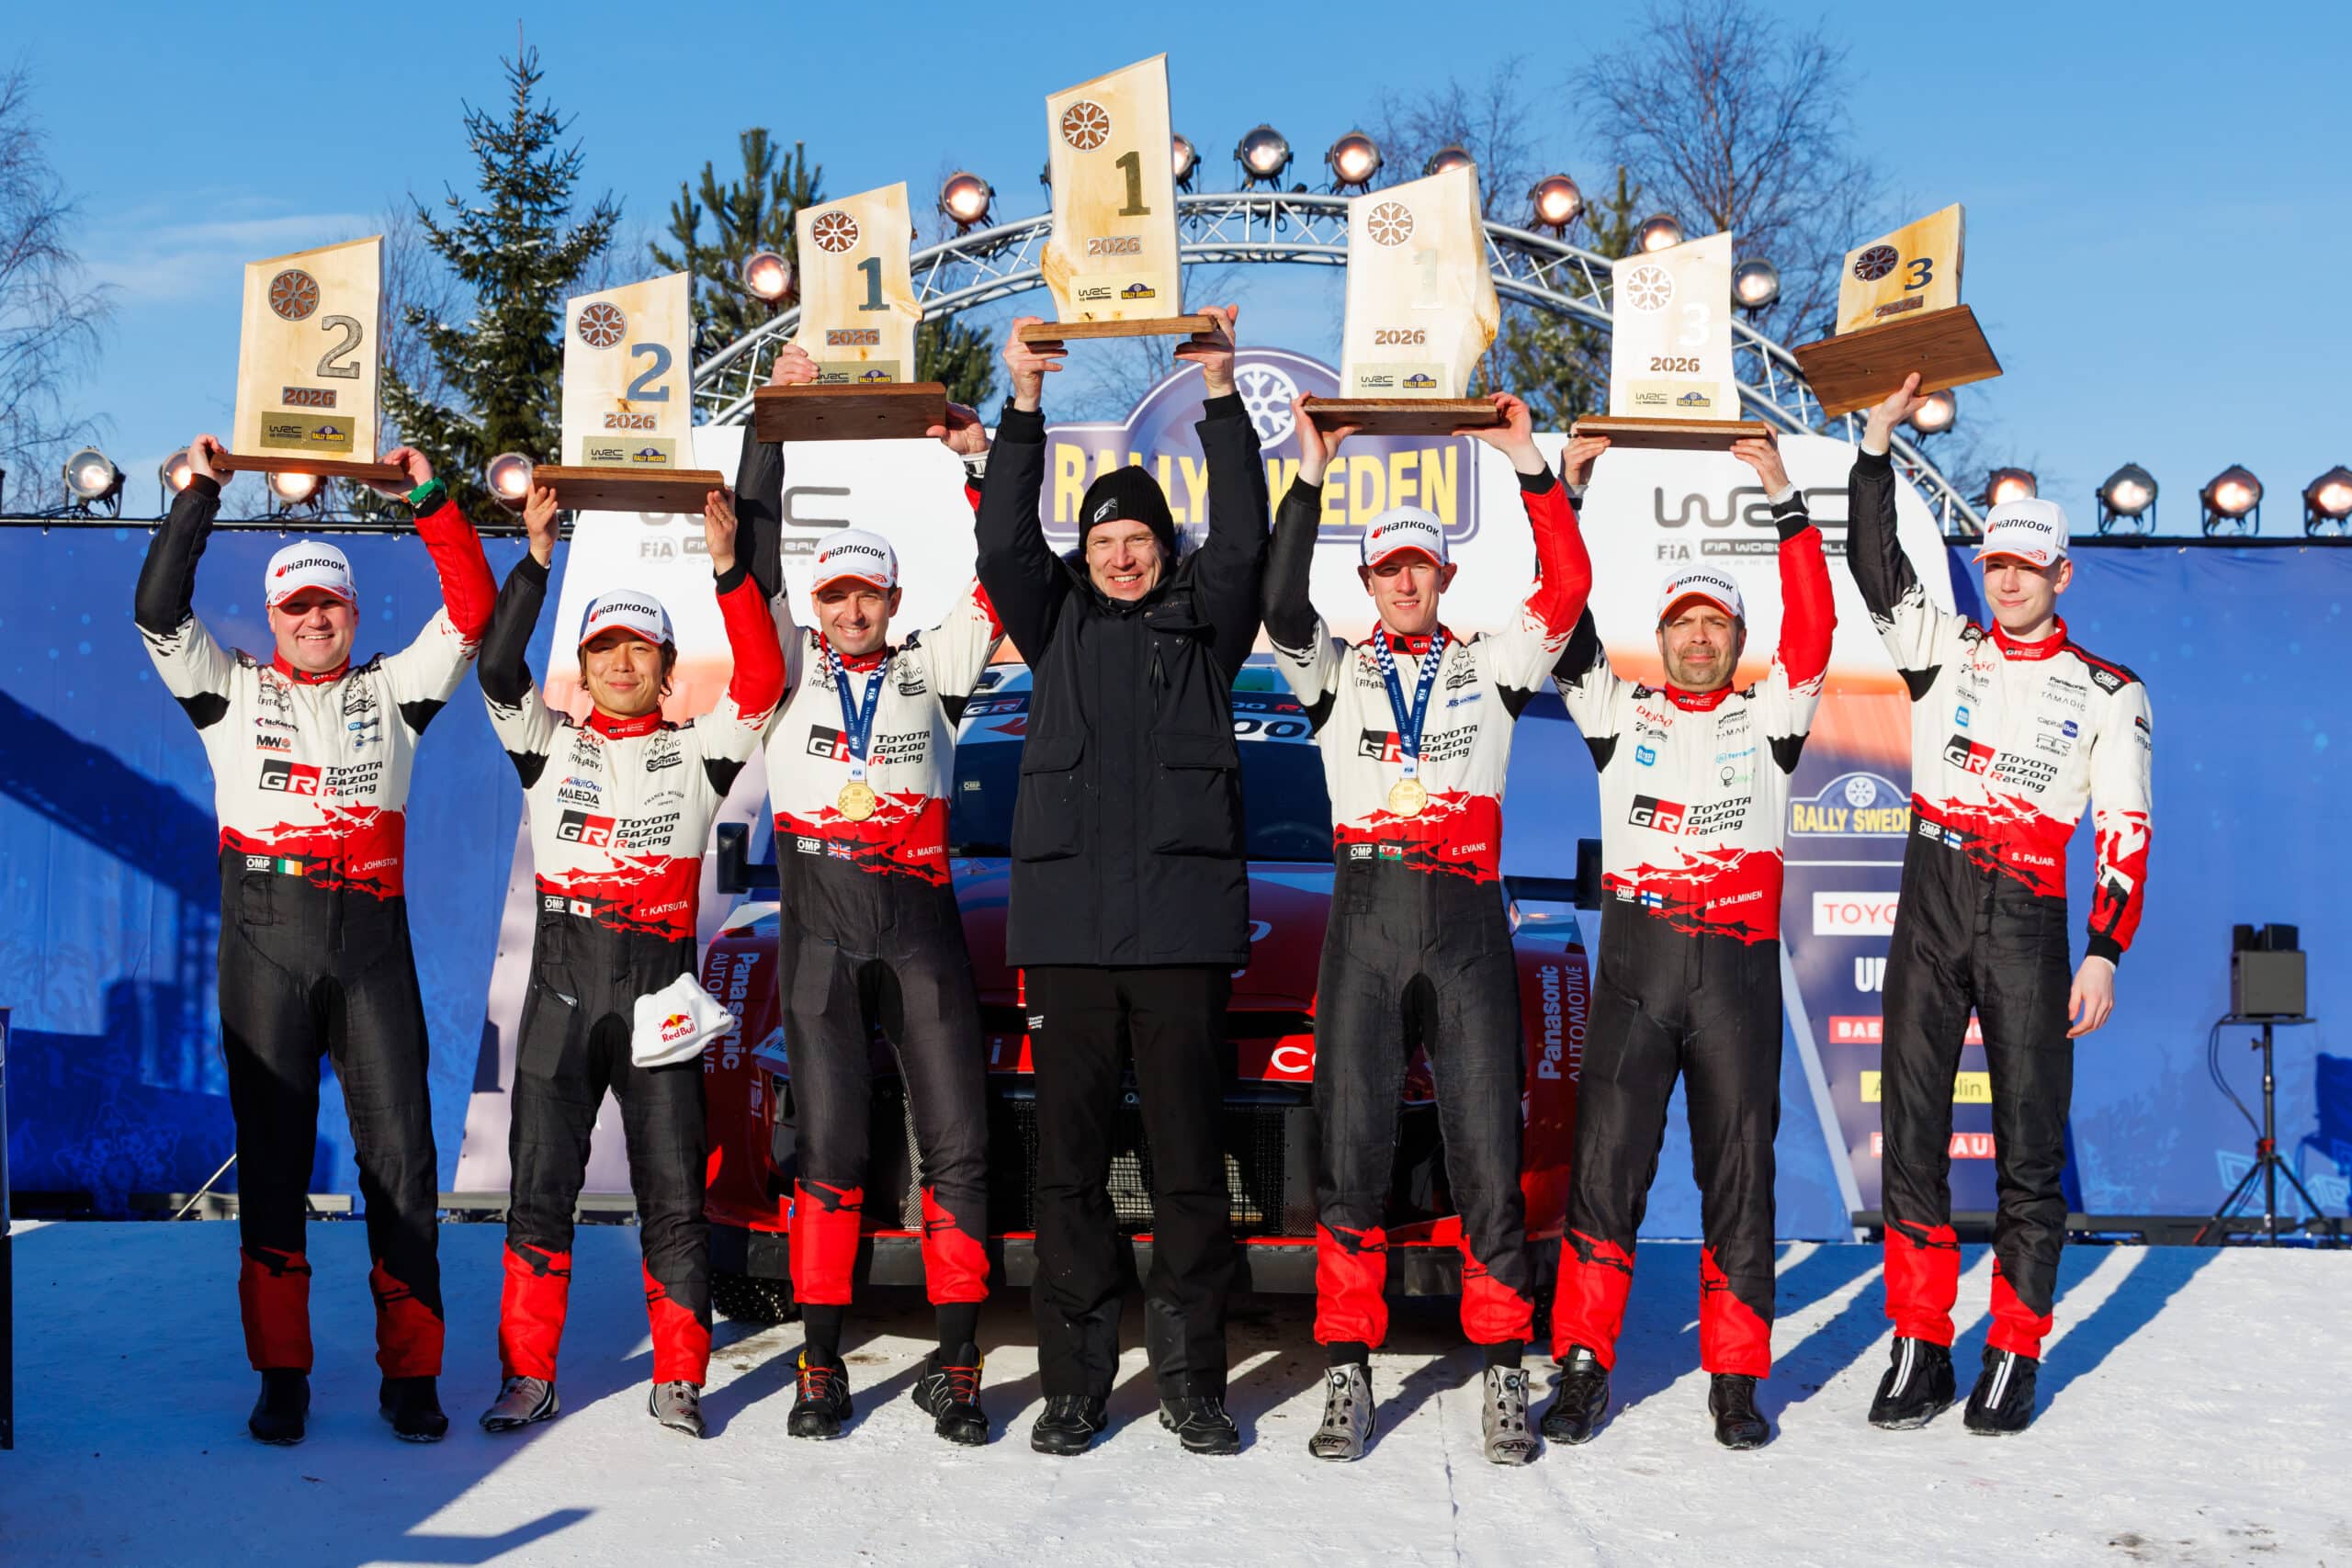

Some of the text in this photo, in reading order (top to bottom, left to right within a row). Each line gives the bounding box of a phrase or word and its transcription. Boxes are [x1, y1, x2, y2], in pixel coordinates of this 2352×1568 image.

[1116, 152, 1150, 216] 1
[1089, 237, 1140, 255] 2026
[1905, 257, 1933, 290] 3
[857, 257, 890, 310] 1
[1678, 302, 1711, 346] 3
[317, 314, 363, 378] 2
[828, 330, 879, 345] 2026
[1374, 329, 1426, 345] 2026
[627, 343, 672, 402] 2
[1650, 356, 1701, 373] 2026
[284, 388, 336, 407] 2026
[605, 413, 656, 429] 2026
[1054, 442, 1457, 526] RLY EDEN
[1635, 705, 1674, 728] DENSO
[874, 730, 931, 744] TOYOTA
[1420, 724, 1478, 743] TOYOTA
[874, 741, 926, 754] GAZOO
[1419, 736, 1473, 752] GAZOO
[871, 753, 923, 766] Racing
[1419, 747, 1470, 762] Racing
[1944, 745, 1988, 775] GR
[1999, 752, 2059, 775] TOYOTA
[326, 761, 383, 776] TOYOTA
[1995, 763, 2052, 783] GAZOO
[259, 771, 318, 796] GR
[325, 773, 379, 786] GAZOO
[1989, 771, 2046, 794] Racing
[322, 784, 377, 796] Racing
[558, 787, 600, 805] MAEDA
[1690, 795, 1752, 815] TOYOTA
[619, 811, 681, 829] TOYOTA
[1630, 807, 1680, 834] GR
[1688, 808, 1746, 825] GAZOO
[1792, 804, 1911, 833] RALLY SWED
[559, 822, 610, 847] GR
[616, 824, 674, 839] GAZOO
[1684, 819, 1743, 836] Racing
[1918, 822, 1940, 837] OMP
[614, 835, 672, 849] Racing
[797, 839, 820, 852] OMP
[917, 845, 943, 857] MARTIN
[1452, 842, 1487, 856] E. EVANS
[1350, 846, 1372, 857] OMP
[2012, 852, 2055, 866] S. PAJAR
[246, 858, 270, 870] OMP
[351, 858, 398, 874] A. JOHNSTON
[1616, 887, 1635, 899] OMP
[1706, 889, 1763, 910] M. SALMINEN
[545, 897, 565, 910] OMP
[639, 899, 689, 918] T. KATSUTA
[1823, 904, 1897, 924] TOYO
[703, 953, 730, 1074] AUTOIVE
[722, 952, 761, 1070] Panasonic
[1535, 964, 1563, 1080] Panasonic
[662, 1022, 695, 1043] Red Bull
